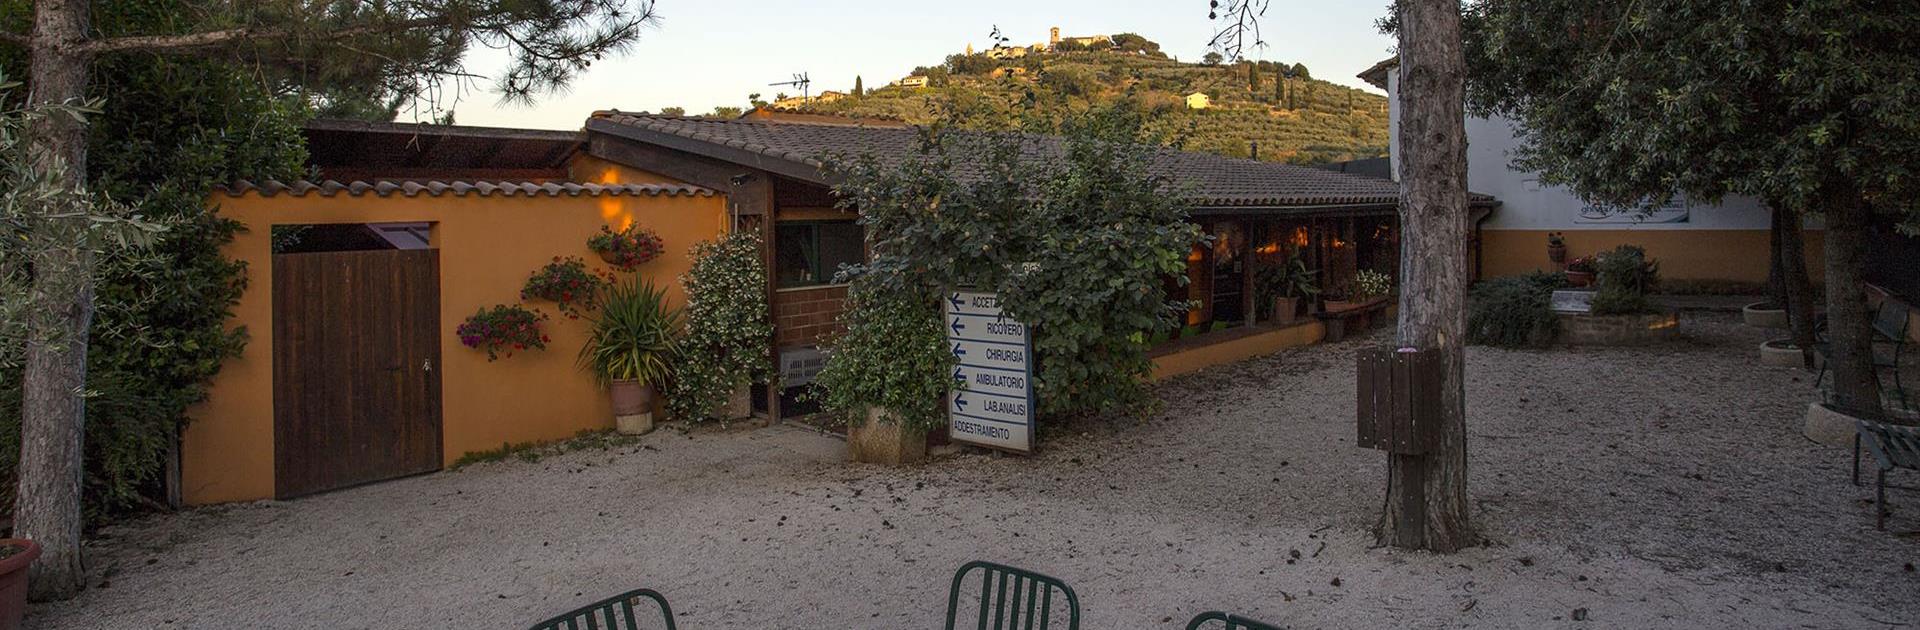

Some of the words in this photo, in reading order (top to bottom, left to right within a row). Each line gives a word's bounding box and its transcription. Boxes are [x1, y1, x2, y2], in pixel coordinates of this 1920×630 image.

[987, 322, 1023, 336] RICOVERO
[986, 348, 1024, 363] CHIRURGIA
[976, 373, 1025, 389] AMBULATORIO
[954, 420, 1010, 440] ADDESTRAMENTO
